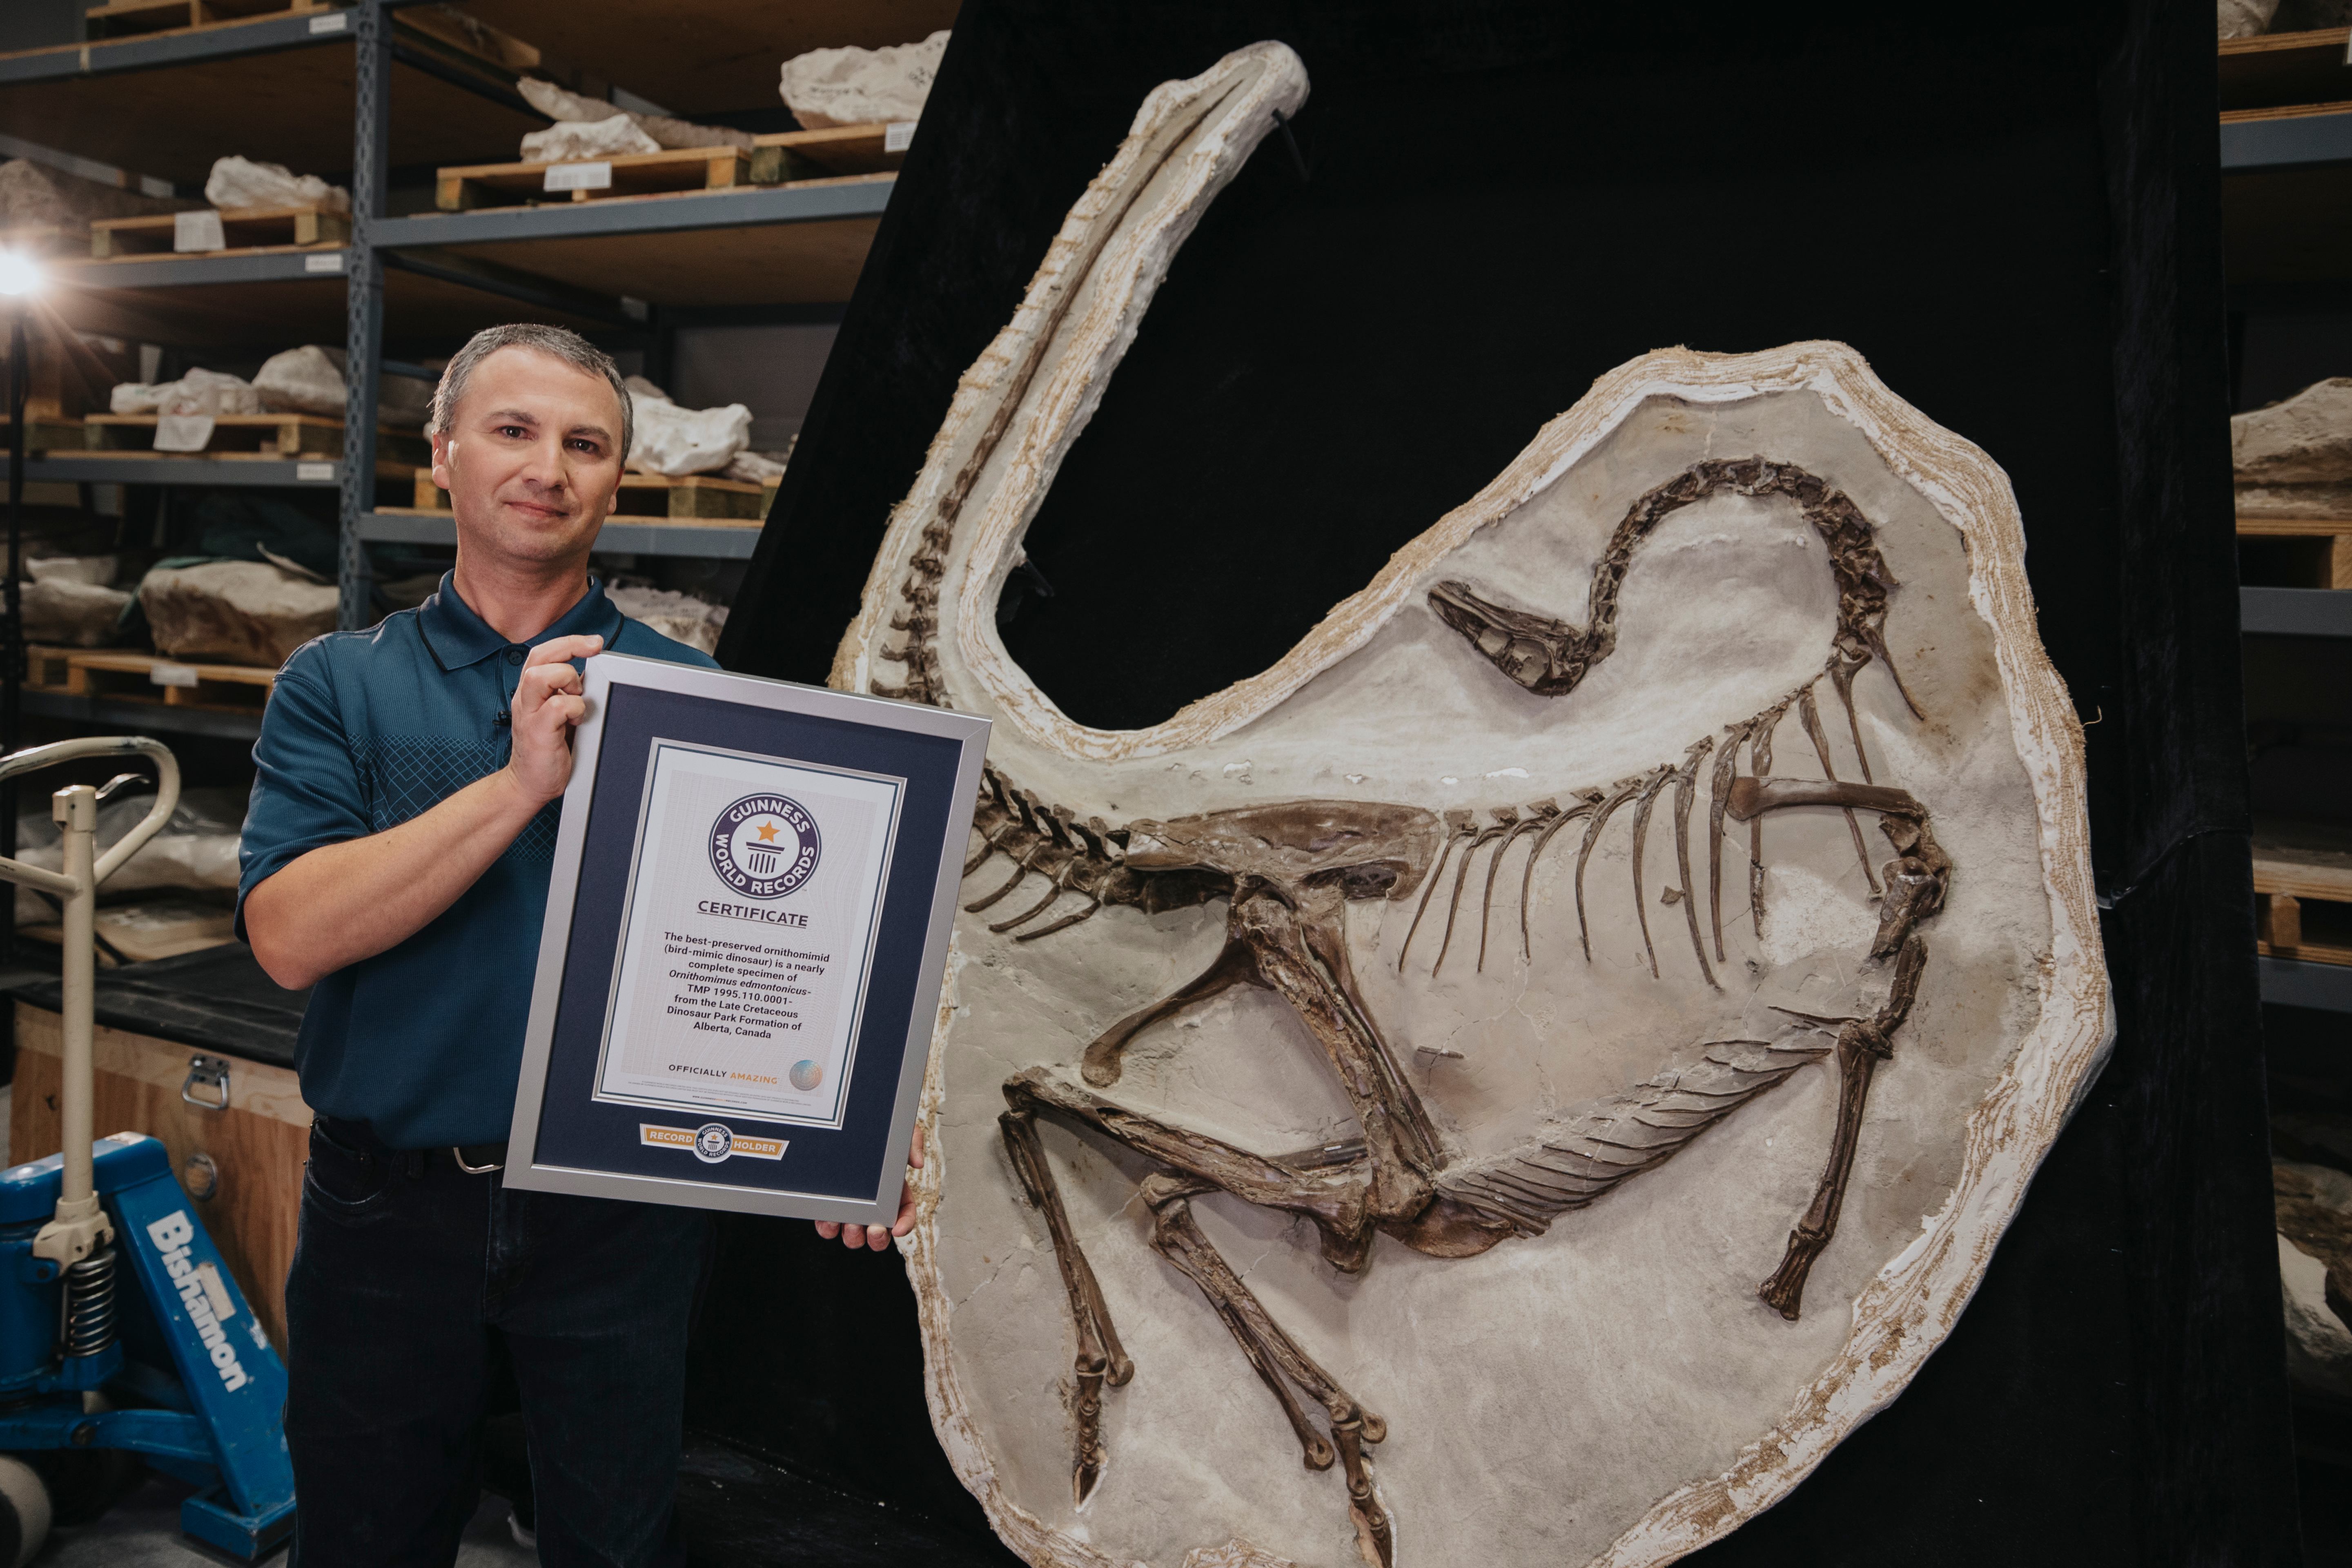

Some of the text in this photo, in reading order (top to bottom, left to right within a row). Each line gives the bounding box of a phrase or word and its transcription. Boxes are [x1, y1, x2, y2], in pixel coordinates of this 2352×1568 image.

[730, 799, 810, 833] GUINNESS
[715, 834, 814, 894] WORLD RECORDS
[698, 900, 808, 927] CERTIFICATE
[665, 932, 829, 962] The best-preserved ornithomimid
[665, 944, 723, 960] (bird-mimic
[726, 953, 772, 968] dinosaur)
[775, 960, 783, 968] is
[795, 964, 825, 975] nearly
[669, 970, 811, 996] Ornithomimus edmontonicus-
[688, 961, 798, 982] complete specimen of
[687, 984, 792, 1004] TMP 1995.110.0001-
[667, 1006, 711, 1019] Dinosaur
[714, 1012, 736, 1022] Park
[739, 1016, 788, 1029] Formation
[675, 994, 798, 1018] from the Late Cretaceous
[693, 1022, 771, 1039] Alberta, Canada
[669, 1065, 777, 1085] OFFICIALLY AMAZING
[650, 1131, 775, 1152] RECORD HOLDER
[702, 1127, 728, 1137] GUINNESS
[698, 1138, 729, 1156] WORLD RECORDS
[146, 1209, 247, 1393] Bishamon
